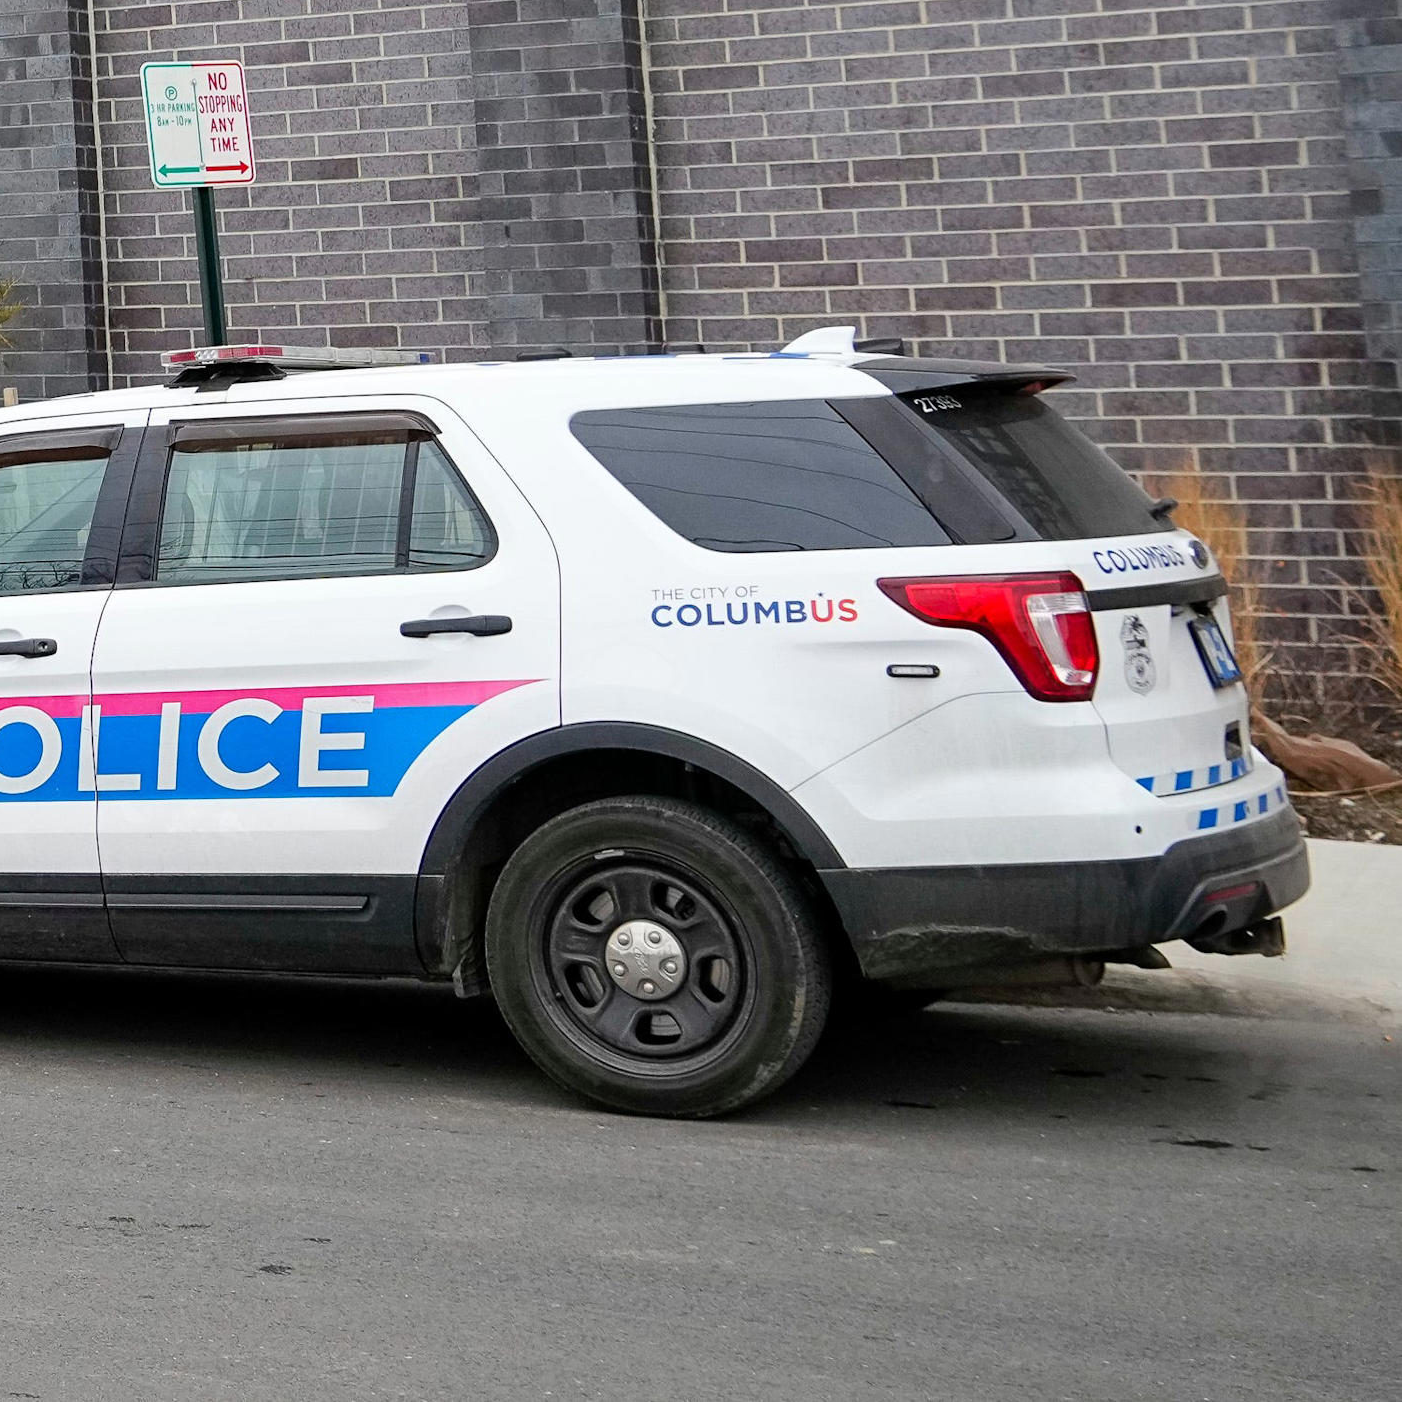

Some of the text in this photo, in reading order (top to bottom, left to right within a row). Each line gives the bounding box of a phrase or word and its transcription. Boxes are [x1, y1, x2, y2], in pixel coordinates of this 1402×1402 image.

[207, 72, 227, 91] NO
[151, 102, 195, 113] 3 HR PARKING
[198, 94, 243, 114] STOPPING
[210, 118, 235, 133] ANY
[210, 136, 240, 153] TIME
[1093, 545, 1185, 574] COLUMBUS
[651, 585, 759, 601] THE CITY OF
[651, 598, 858, 628] COLUMBUS
